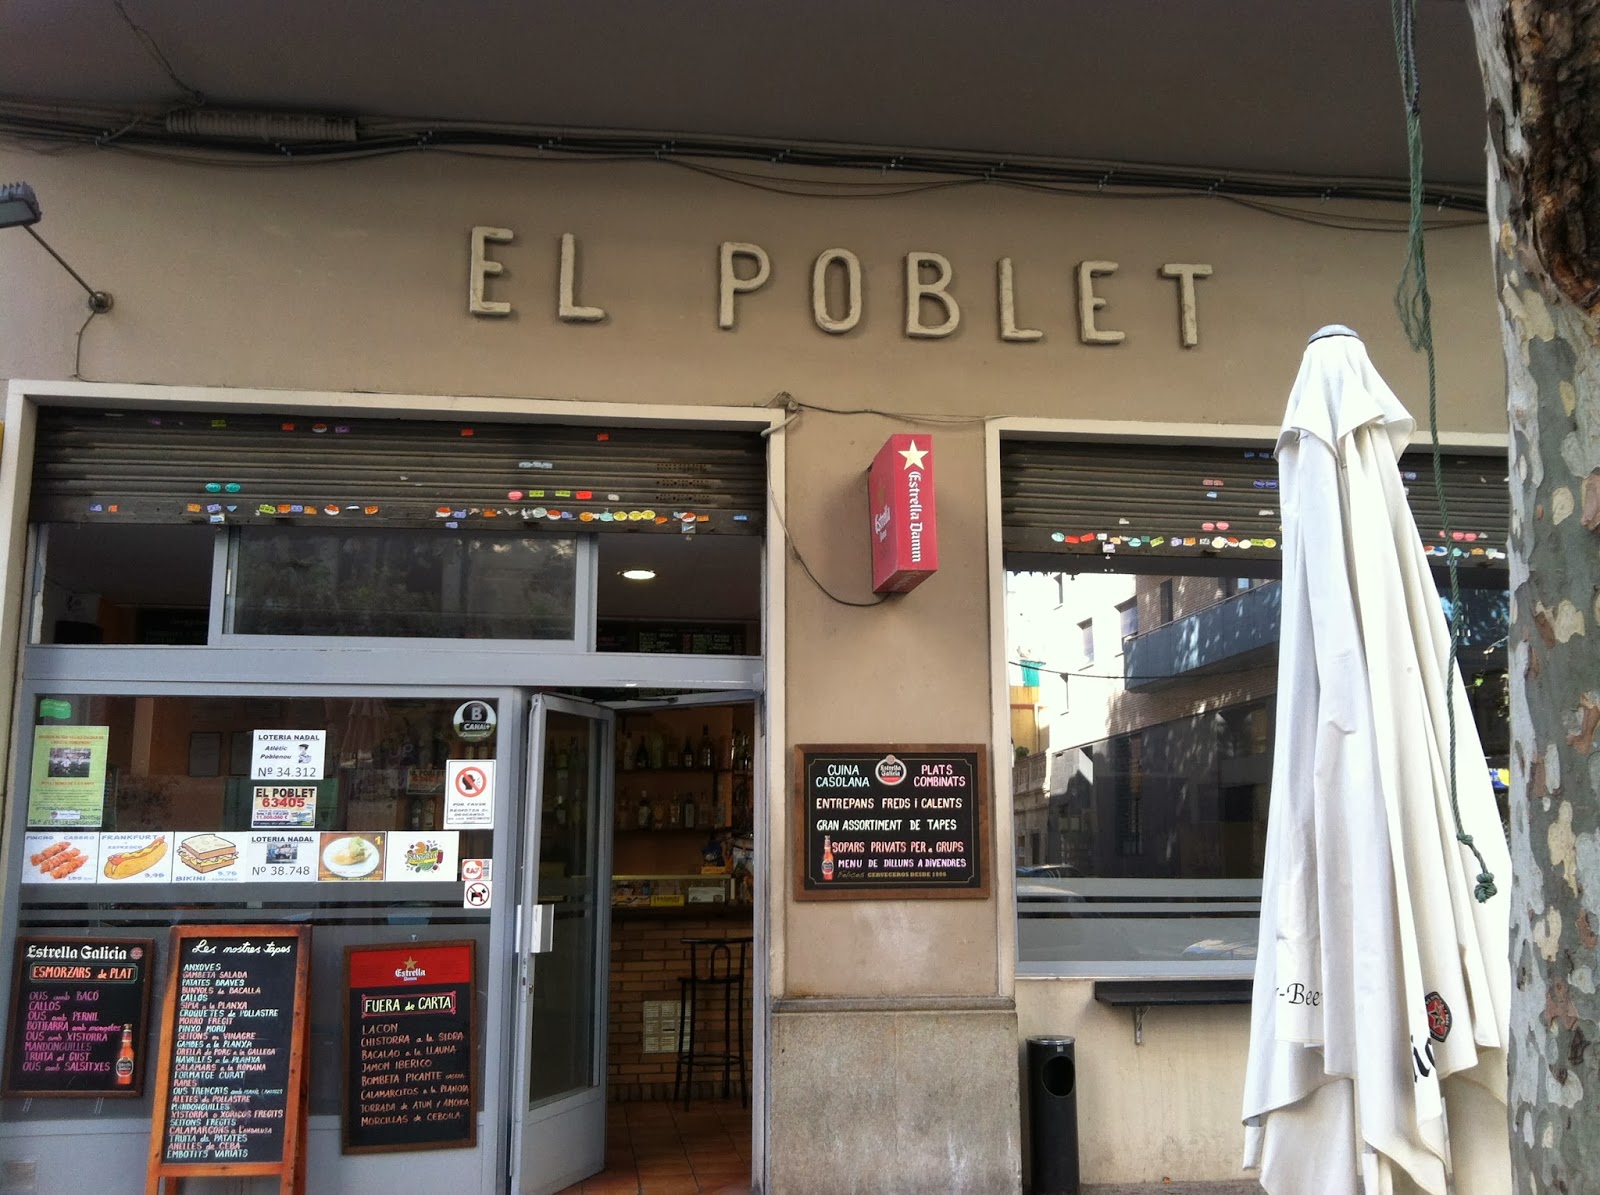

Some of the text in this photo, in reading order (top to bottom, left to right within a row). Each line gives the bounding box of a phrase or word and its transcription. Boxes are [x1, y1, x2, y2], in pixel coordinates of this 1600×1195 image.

[469, 225, 1213, 350] EL POBLET
[908, 471, 923, 520] Estrella
[910, 522, 923, 562] Damm
[277, 767, 316, 777] 34.312
[827, 764, 859, 775] CUINA
[921, 764, 953, 775] PLATS
[816, 776, 870, 788] CASOLANA
[256, 788, 315, 797] EL POBLET
[262, 798, 305, 807] 63405
[816, 798, 874, 809] ENTREPANS
[882, 798, 911, 809] FREDS
[921, 798, 963, 809] CALENTS
[817, 819, 957, 831] GRAN ASSORTIMENT DE TAPES
[832, 842, 865, 853] SOPARS
[910, 842, 926, 852] PER
[936, 841, 964, 853] GRUPS
[838, 859, 862, 868] MENU
[868, 859, 878, 868] DE
[270, 866, 310, 876] 38.748
[26, 945, 127, 960] Estrella Galicia
[223, 941, 261, 953] nostres
[263, 941, 291, 956] tapes
[184, 963, 221, 971] ANXOVES
[32, 966, 91, 978] ESMORZARS
[109, 968, 134, 978] PLAT
[395, 968, 426, 977] Estrella
[29, 992, 48, 1001] OUS
[29, 1001, 61, 1010] CALLOS
[364, 996, 451, 1013] FUERA de CARTA
[28, 1011, 47, 1020] OUS
[27, 1021, 69, 1030] BOTIFARRA
[26, 1032, 45, 1041] OUS
[67, 1033, 108, 1041] XISTORRA
[178, 1032, 256, 1040] SEITONS VINAGRE
[361, 1032, 465, 1048] CHISTORRA SIDRA
[177, 1040, 204, 1048] GAMBES
[69, 1052, 91, 1061] GUST
[176, 1048, 201, 1056] ORELLA
[361, 1050, 400, 1060] BACALAO
[23, 1062, 41, 1071] OUS
[64, 1062, 110, 1071] SALSITXES
[395, 1059, 432, 1070] IBERICO
[174, 1071, 245, 1079] FORMATGE CURAT
[361, 1072, 443, 1087] BOMBETA PICANTE
[191, 1087, 228, 1095] TRENCATS
[361, 1087, 419, 1100] CALAMARCITOS
[412, 1100, 433, 1109] ATUN
[171, 1110, 208, 1118] XISTORRA
[254, 1110, 283, 1118] FREGITS
[361, 1114, 408, 1127] MORCILLAS
[170, 1134, 196, 1142] TRUITA
[214, 1134, 248, 1142] PATATES
[167, 1149, 248, 1158] EMBOTITS VARIATS
